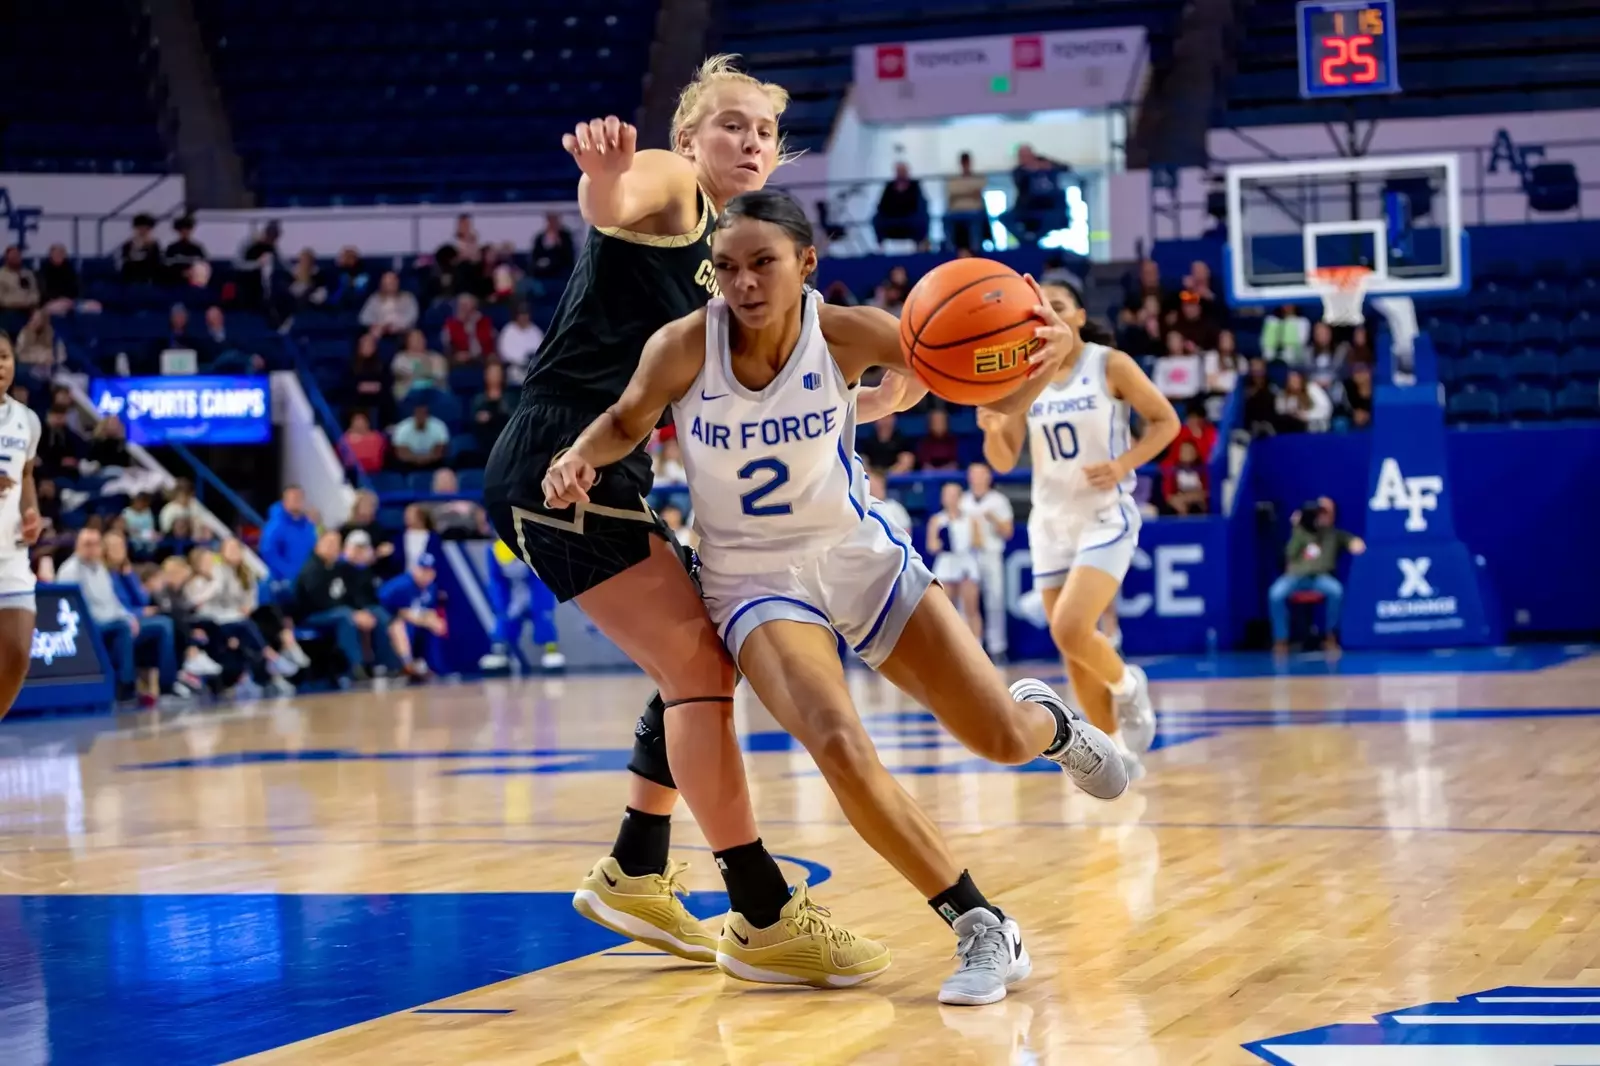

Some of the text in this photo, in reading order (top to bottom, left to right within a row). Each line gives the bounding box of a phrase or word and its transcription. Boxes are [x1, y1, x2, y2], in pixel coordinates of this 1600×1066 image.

[1321, 36, 1376, 84] 25
[126, 389, 198, 420] SPORTS
[200, 388, 265, 418] CAMPS
[1047, 395, 1098, 415] FORCE
[691, 406, 838, 450] AIR FORCE
[1042, 420, 1079, 461] 10
[737, 456, 793, 516] 2
[1368, 457, 1443, 532] AF
